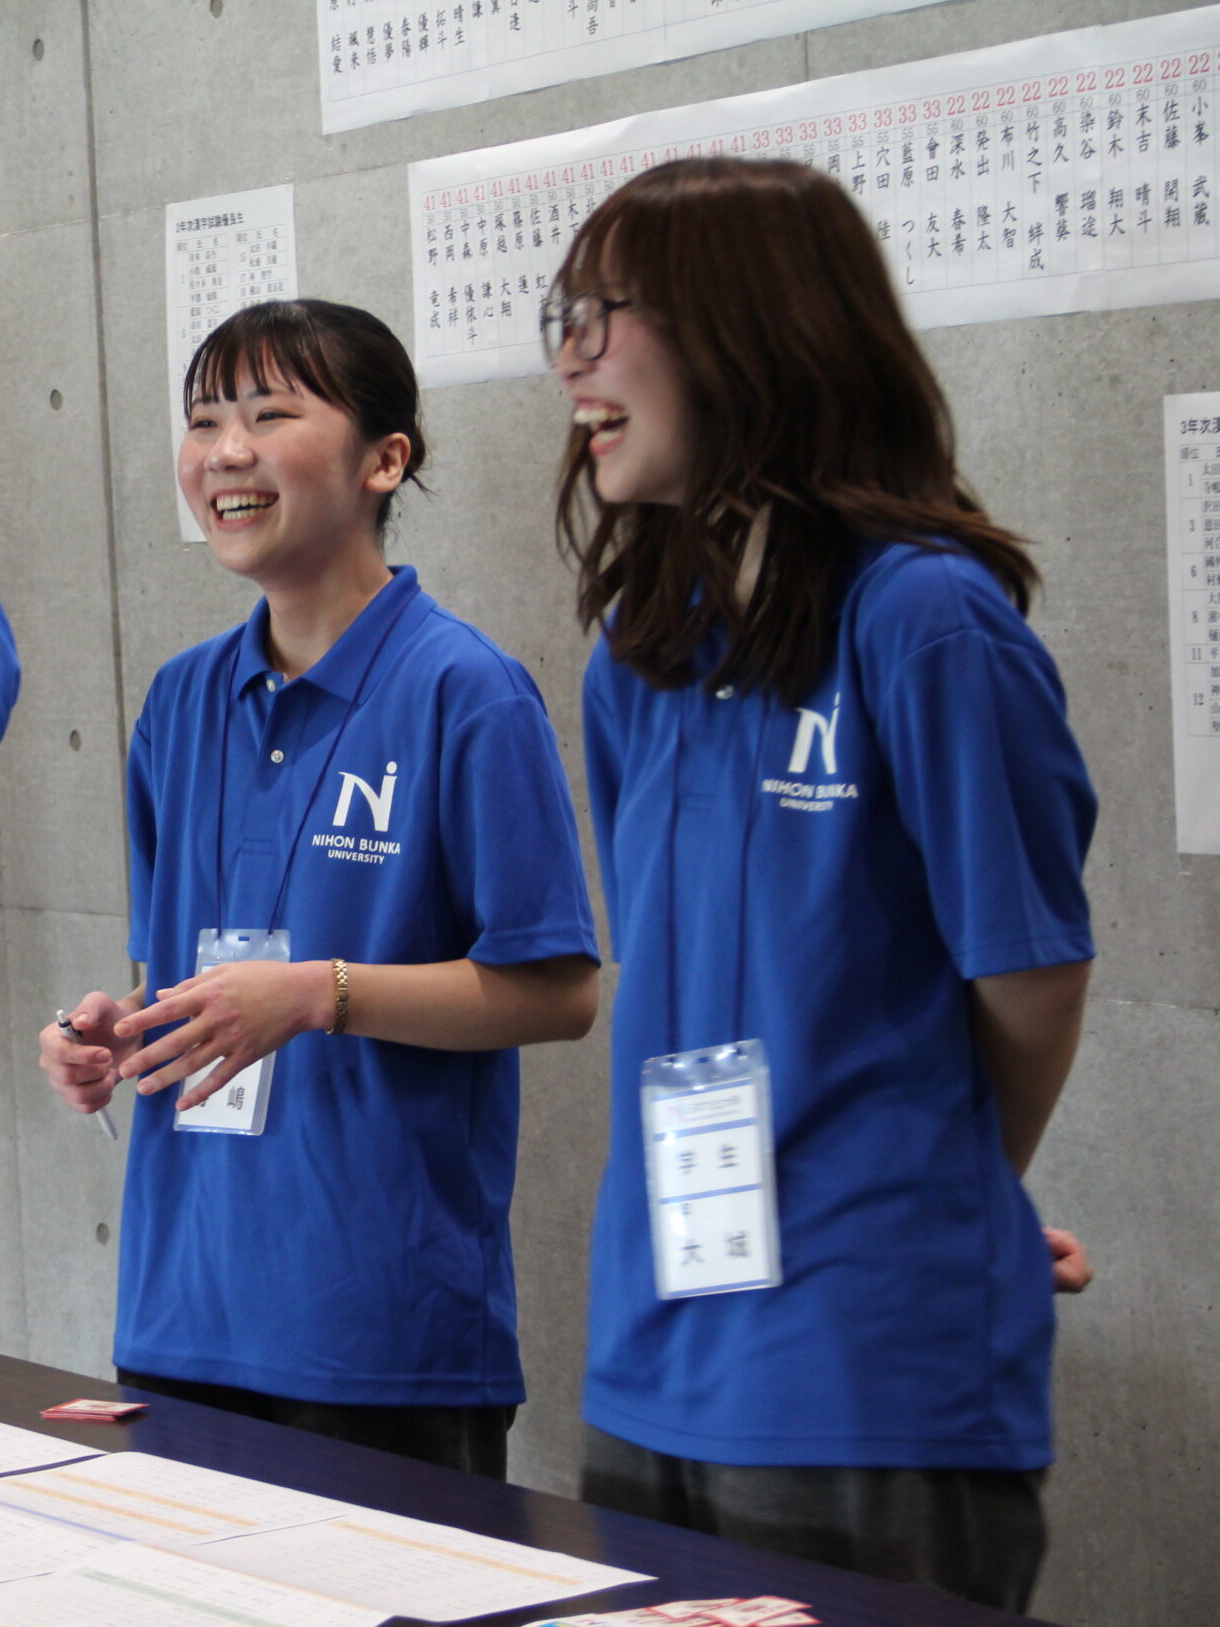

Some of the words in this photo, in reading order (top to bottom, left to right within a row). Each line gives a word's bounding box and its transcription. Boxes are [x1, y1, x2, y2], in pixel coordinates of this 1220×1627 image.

[423, 196, 436, 211] 41
[440, 192, 453, 207] 41
[457, 189, 470, 204] 41
[474, 185, 487, 200] 41
[491, 181, 504, 197] 41
[508, 178, 521, 194] 41
[525, 174, 539, 190] 41
[543, 171, 557, 187] 41
[562, 167, 576, 183] 41
[580, 163, 595, 180] 41
[601, 160, 614, 176] 41
[620, 156, 635, 173] 41
[641, 152, 656, 169] 41
[752, 130, 771, 149] 33
[775, 126, 794, 146] 33
[799, 121, 818, 141] 33
[823, 117, 843, 136] 33
[848, 112, 868, 132] 33
[873, 108, 893, 128] 33
[898, 104, 917, 124] 33
[923, 99, 942, 119] 33
[947, 95, 966, 115] 22
[972, 90, 991, 111] 22
[996, 86, 1016, 106] 22
[1021, 81, 1042, 102] 22
[1048, 76, 1069, 98] 22
[1075, 71, 1097, 93] 22
[1104, 67, 1125, 89] 22
[1132, 63, 1154, 85] 22
[1160, 57, 1182, 80] 22
[1188, 52, 1211, 75] 22
[1053, 116, 1069, 164] 高久
[1107, 109, 1124, 158] 鈴木
[1163, 100, 1180, 150] 佐藤
[852, 151, 866, 195] 上野
[876, 146, 890, 189] 穴田
[950, 133, 966, 180] 深水
[1026, 120, 1043, 193] 竹之下
[926, 212, 941, 258] 友大
[1002, 201, 1017, 248] 大智
[901, 220, 915, 285] つくし
[312, 834, 355, 849] NIHON
[359, 838, 401, 854] BUNKA
[328, 849, 385, 865] UNIVERSITY
